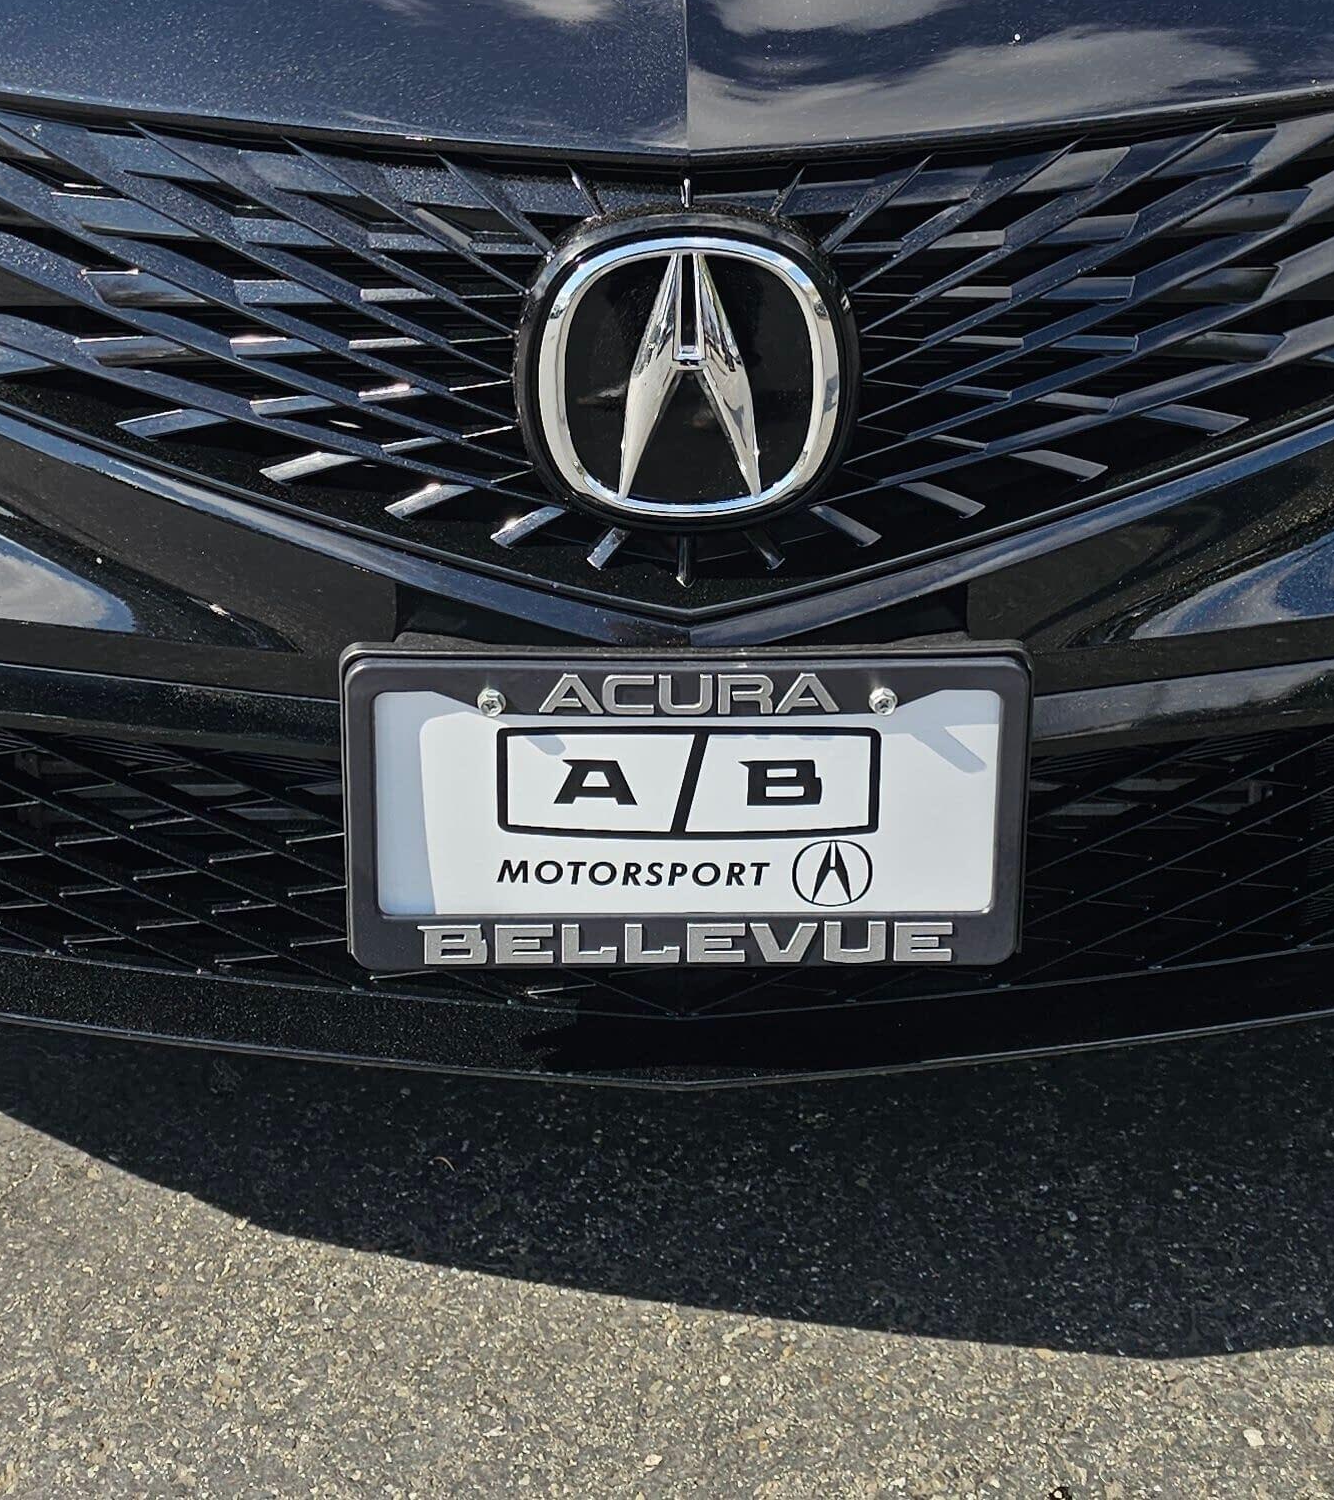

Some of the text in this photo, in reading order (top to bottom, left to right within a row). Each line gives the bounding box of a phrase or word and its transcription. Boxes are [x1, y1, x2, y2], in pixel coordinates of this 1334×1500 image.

[538, 672, 840, 716] ACURA
[495, 858, 770, 888] MOTORSPORT
[416, 921, 954, 965] BELLEVUE
